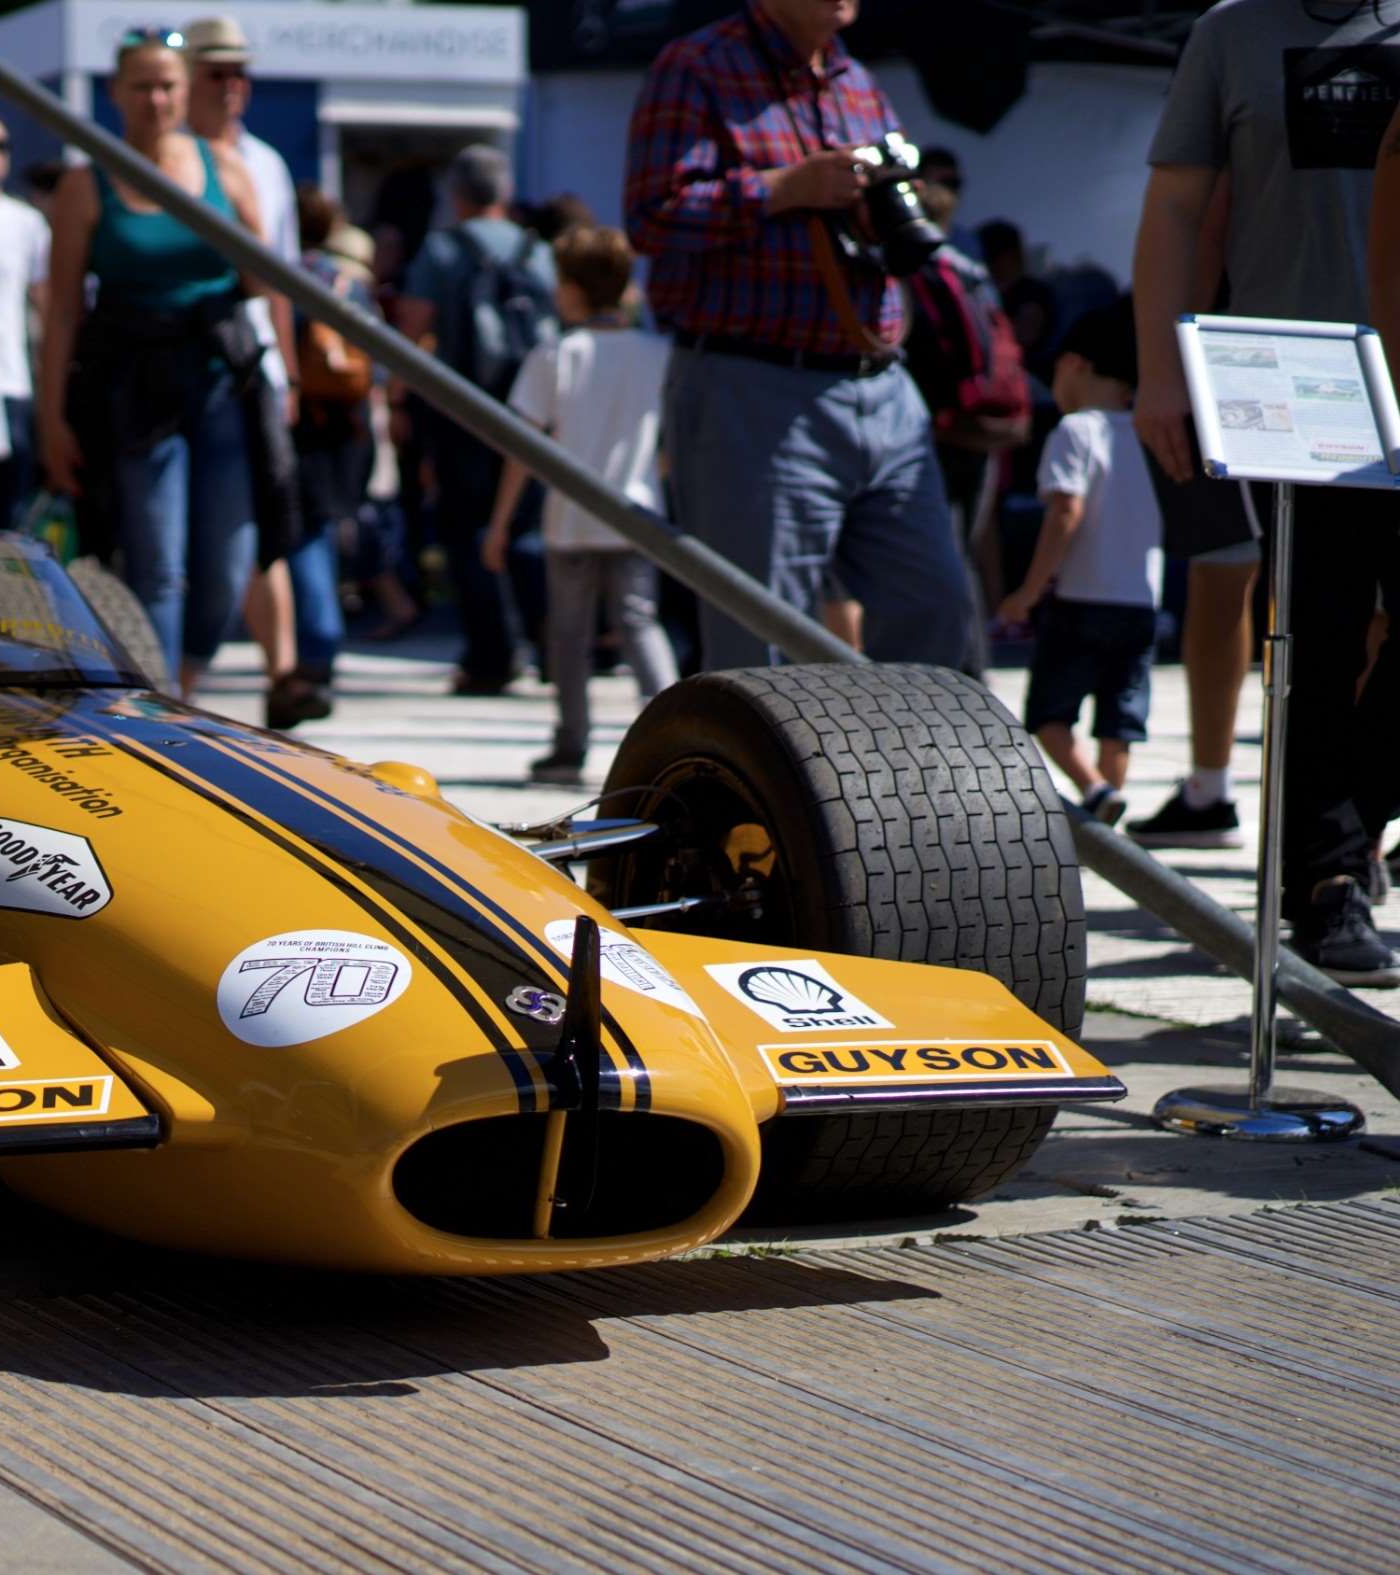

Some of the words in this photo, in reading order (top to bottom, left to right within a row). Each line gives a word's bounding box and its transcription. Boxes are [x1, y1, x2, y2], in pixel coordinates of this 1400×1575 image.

[315, 940, 345, 948] BRITISH
[238, 957, 399, 1019] 70
[782, 1015, 877, 1029] Shell
[778, 1047, 1058, 1075] GUYSON
